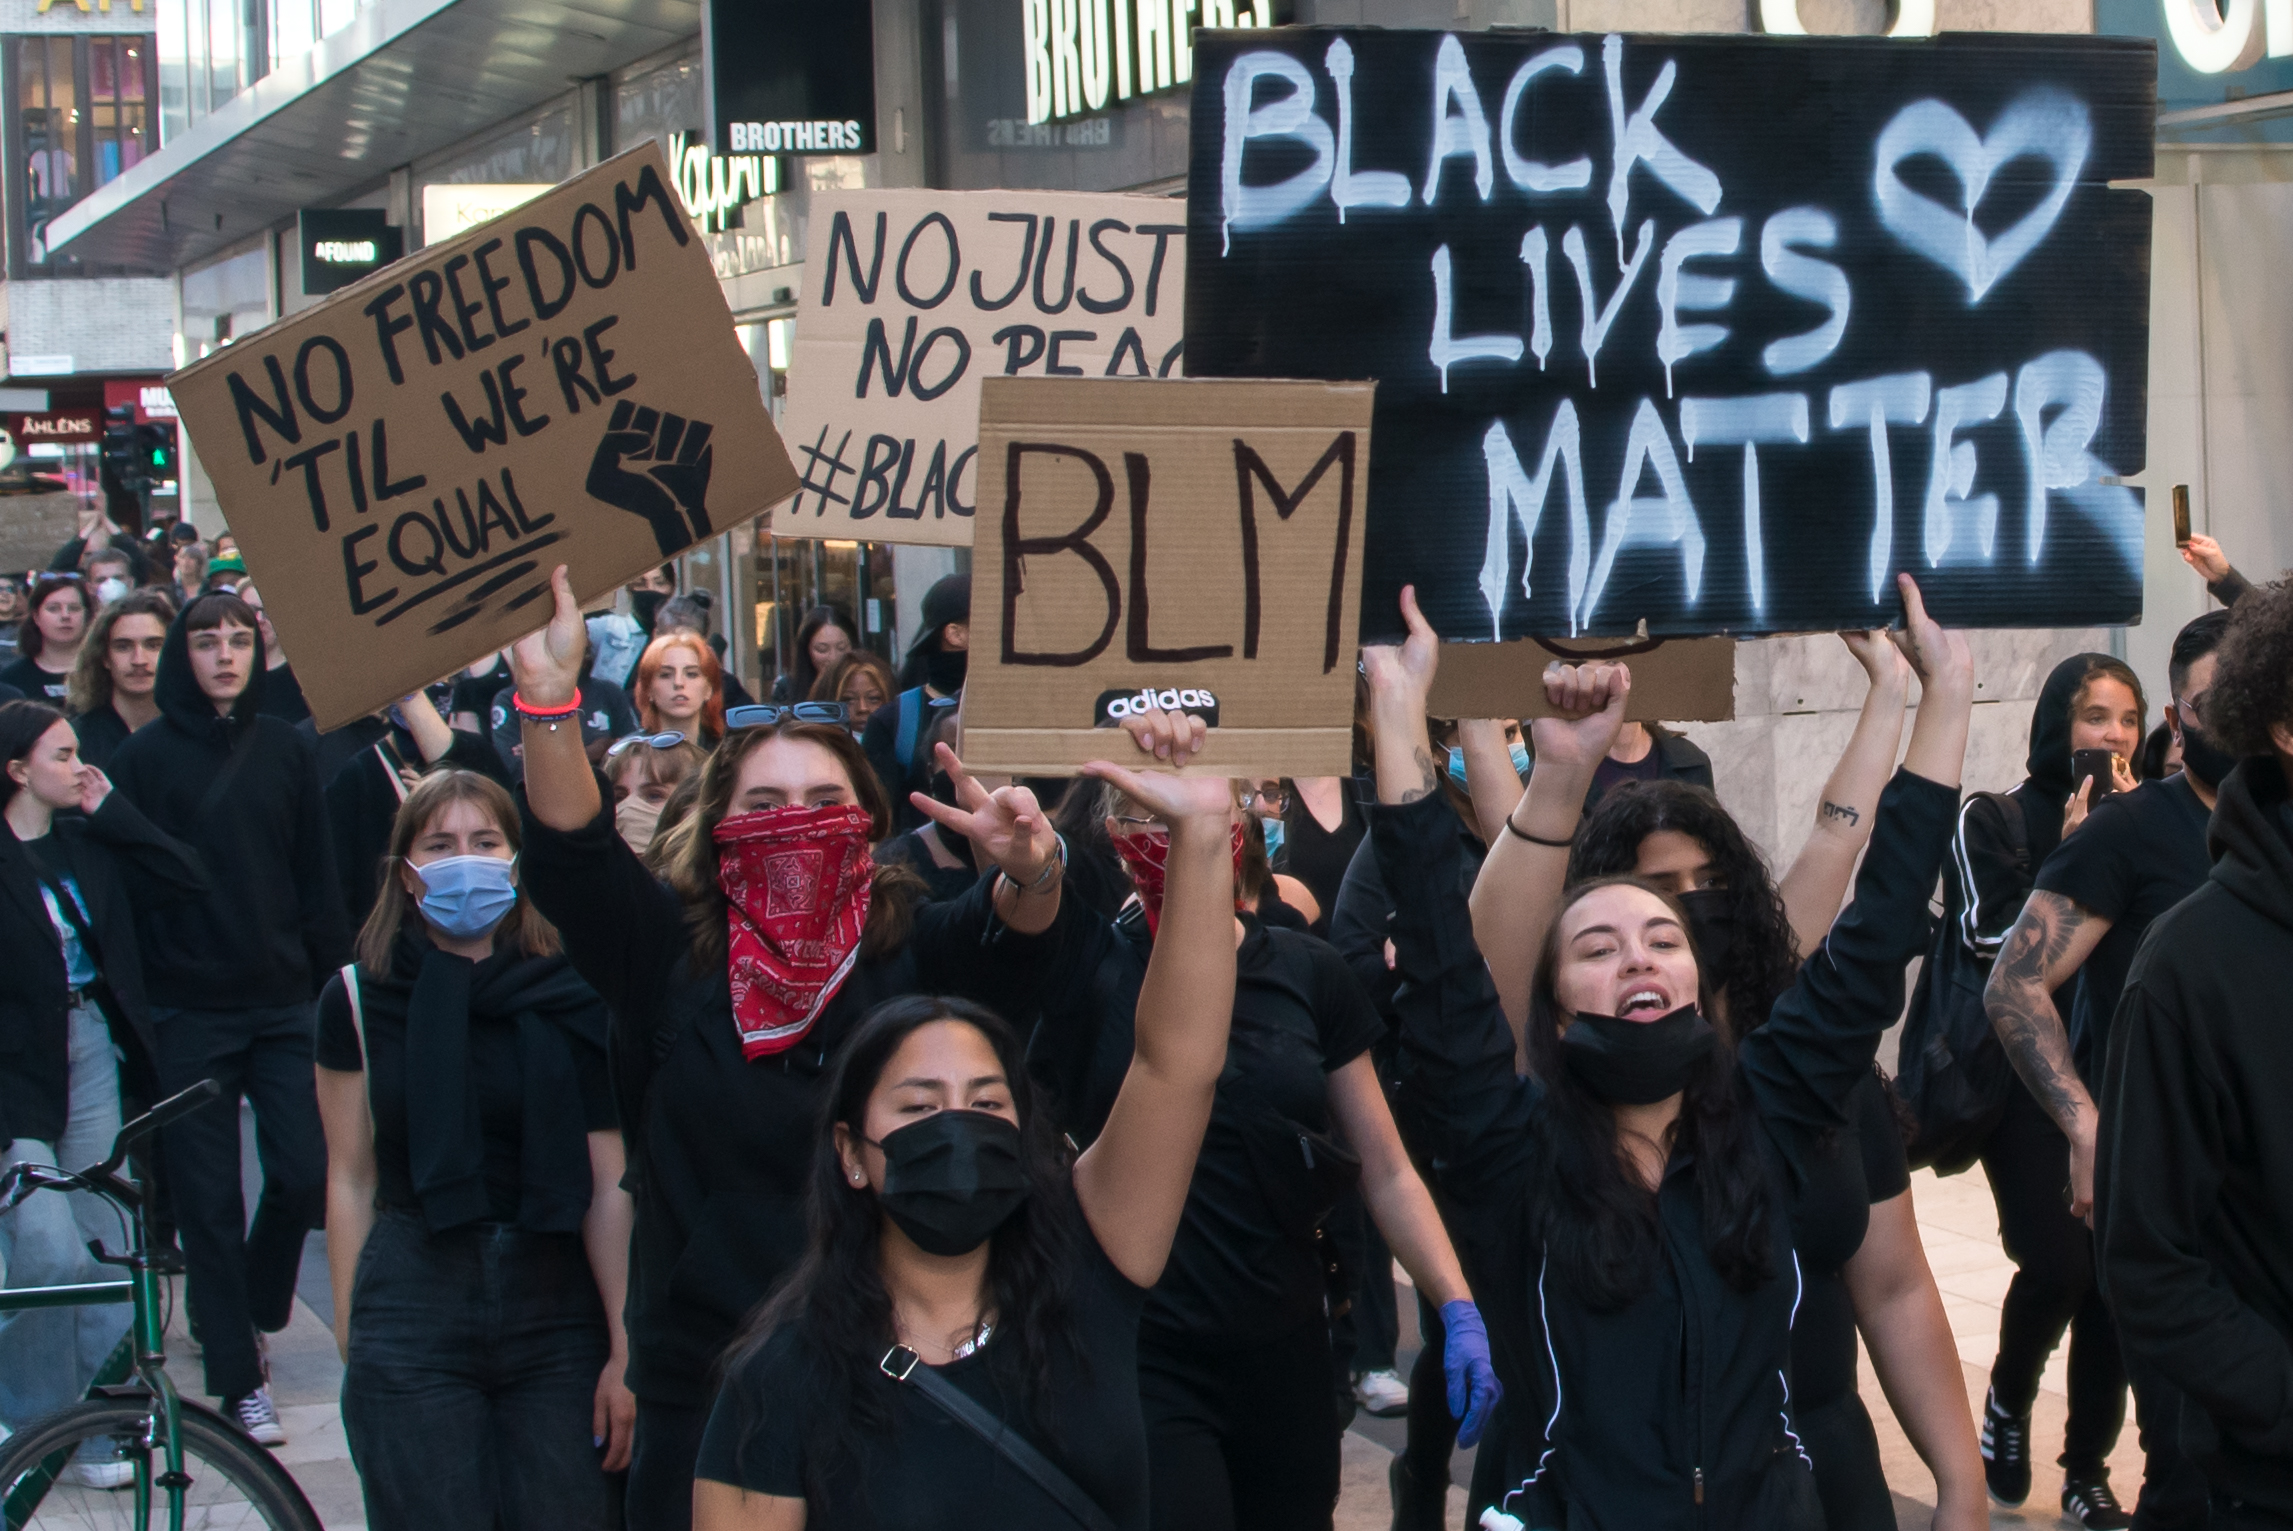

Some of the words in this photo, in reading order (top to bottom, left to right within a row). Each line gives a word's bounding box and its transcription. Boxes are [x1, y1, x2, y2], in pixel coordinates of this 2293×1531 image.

[730, 120, 862, 151] BROTHERS
[1022, 0, 1271, 126] BROTHE
[1222, 33, 1723, 262] BLACK
[227, 336, 354, 465] NO
[365, 164, 689, 386] FREEDOM
[315, 242, 376, 262] AFOUND
[822, 211, 961, 309] NO
[1429, 206, 1850, 398] LIVES
[270, 418, 427, 533] 'TIL
[441, 314, 637, 453] WE'RE
[856, 316, 971, 400] NO
[343, 467, 556, 615] EQUAL
[1001, 431, 1356, 675] BLM
[1478, 350, 2145, 642] MATTER
[1107, 688, 1215, 718] adidas
